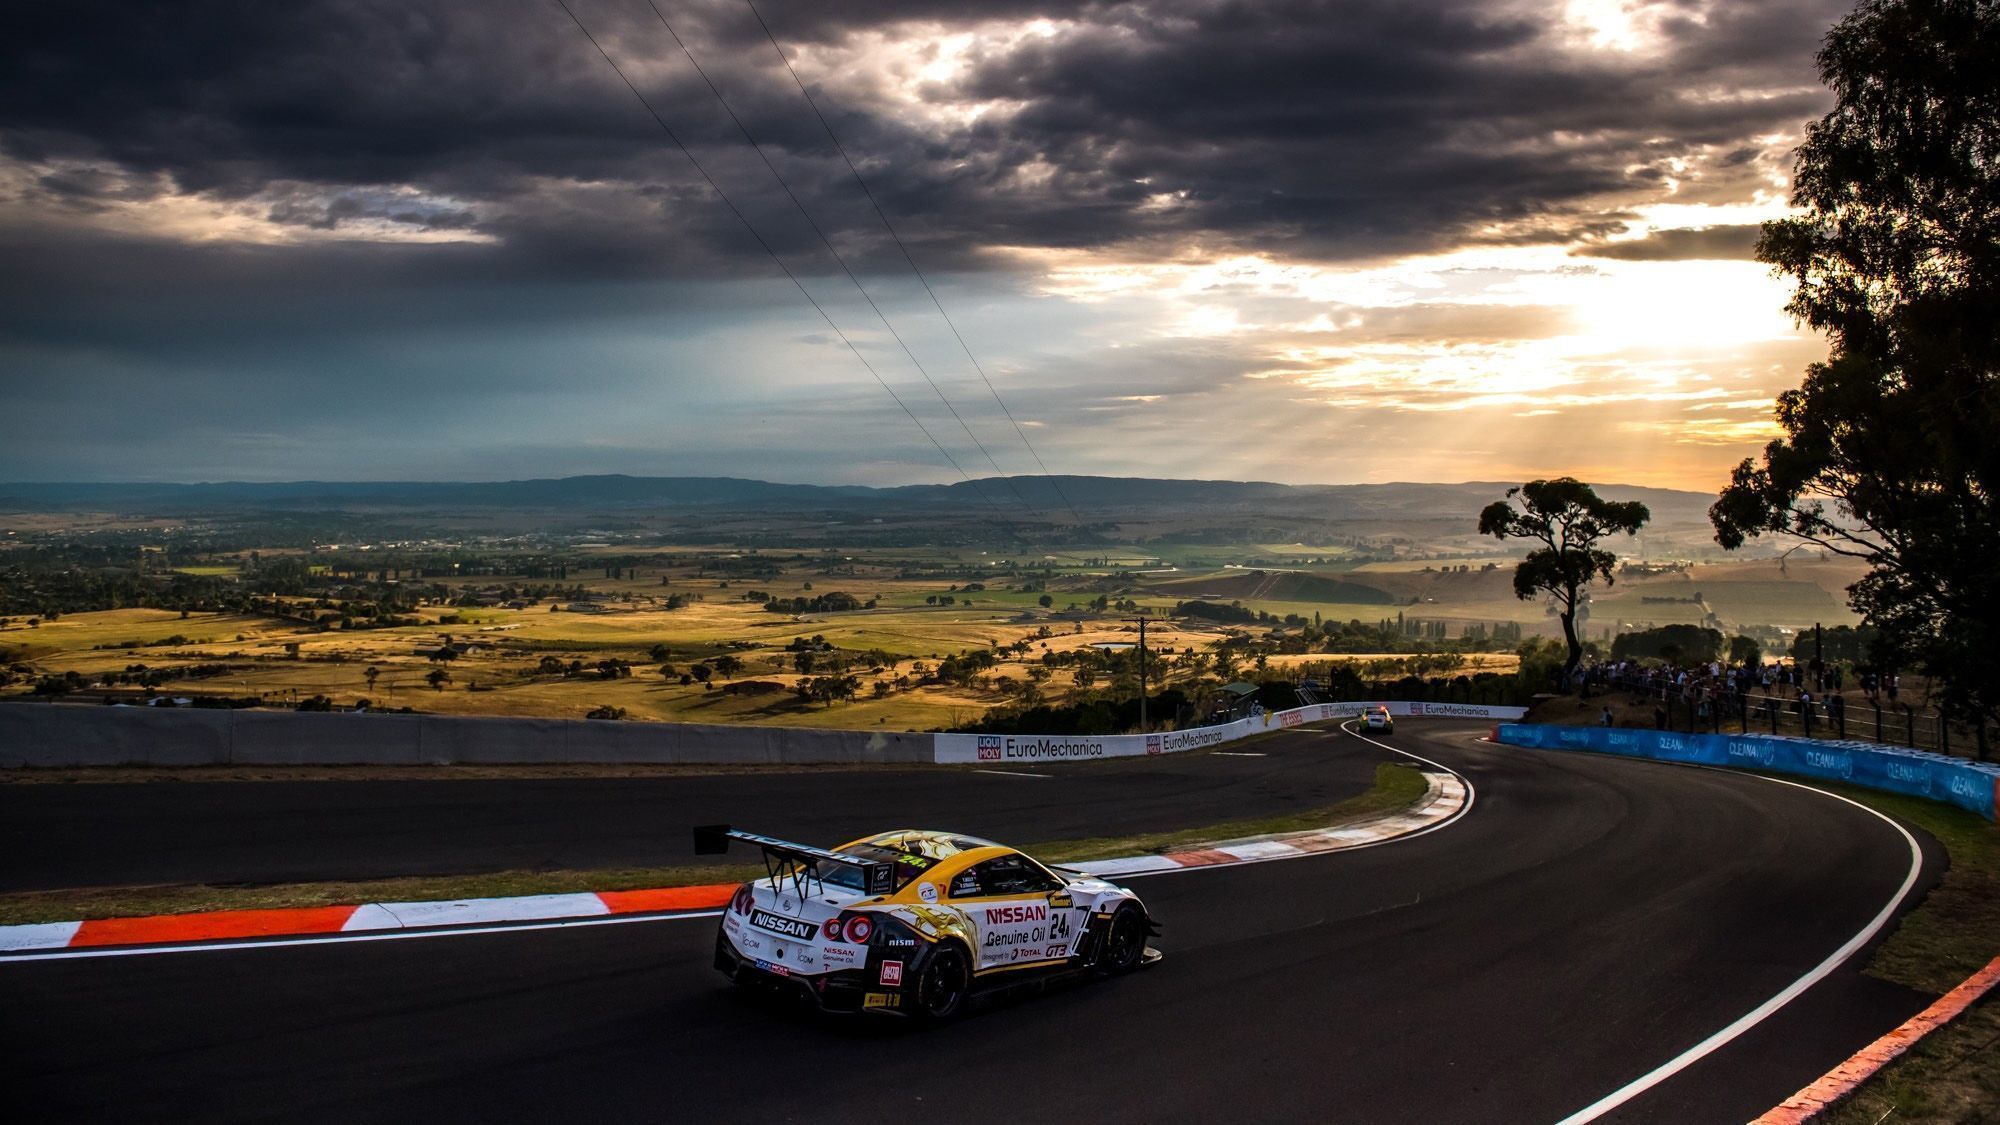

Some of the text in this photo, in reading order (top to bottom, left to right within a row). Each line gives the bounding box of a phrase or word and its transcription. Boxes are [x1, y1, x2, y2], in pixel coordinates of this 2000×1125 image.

[1425, 704, 1489, 716] EuroMechanica
[978, 736, 1000, 749] LIQUI
[1163, 729, 1222, 751] EuroMechanica
[978, 748, 1000, 760] MOLY
[1006, 739, 1102, 758] EuroMechanica
[986, 905, 1046, 924] NISSAN
[754, 913, 810, 938] NISSAN
[986, 927, 1046, 946] Genuine Oil
[823, 947, 855, 956] NISSAN
[1020, 949, 1042, 957] TOTAL
[1045, 945, 1068, 957] GT3
[823, 954, 844, 963] Genuine
